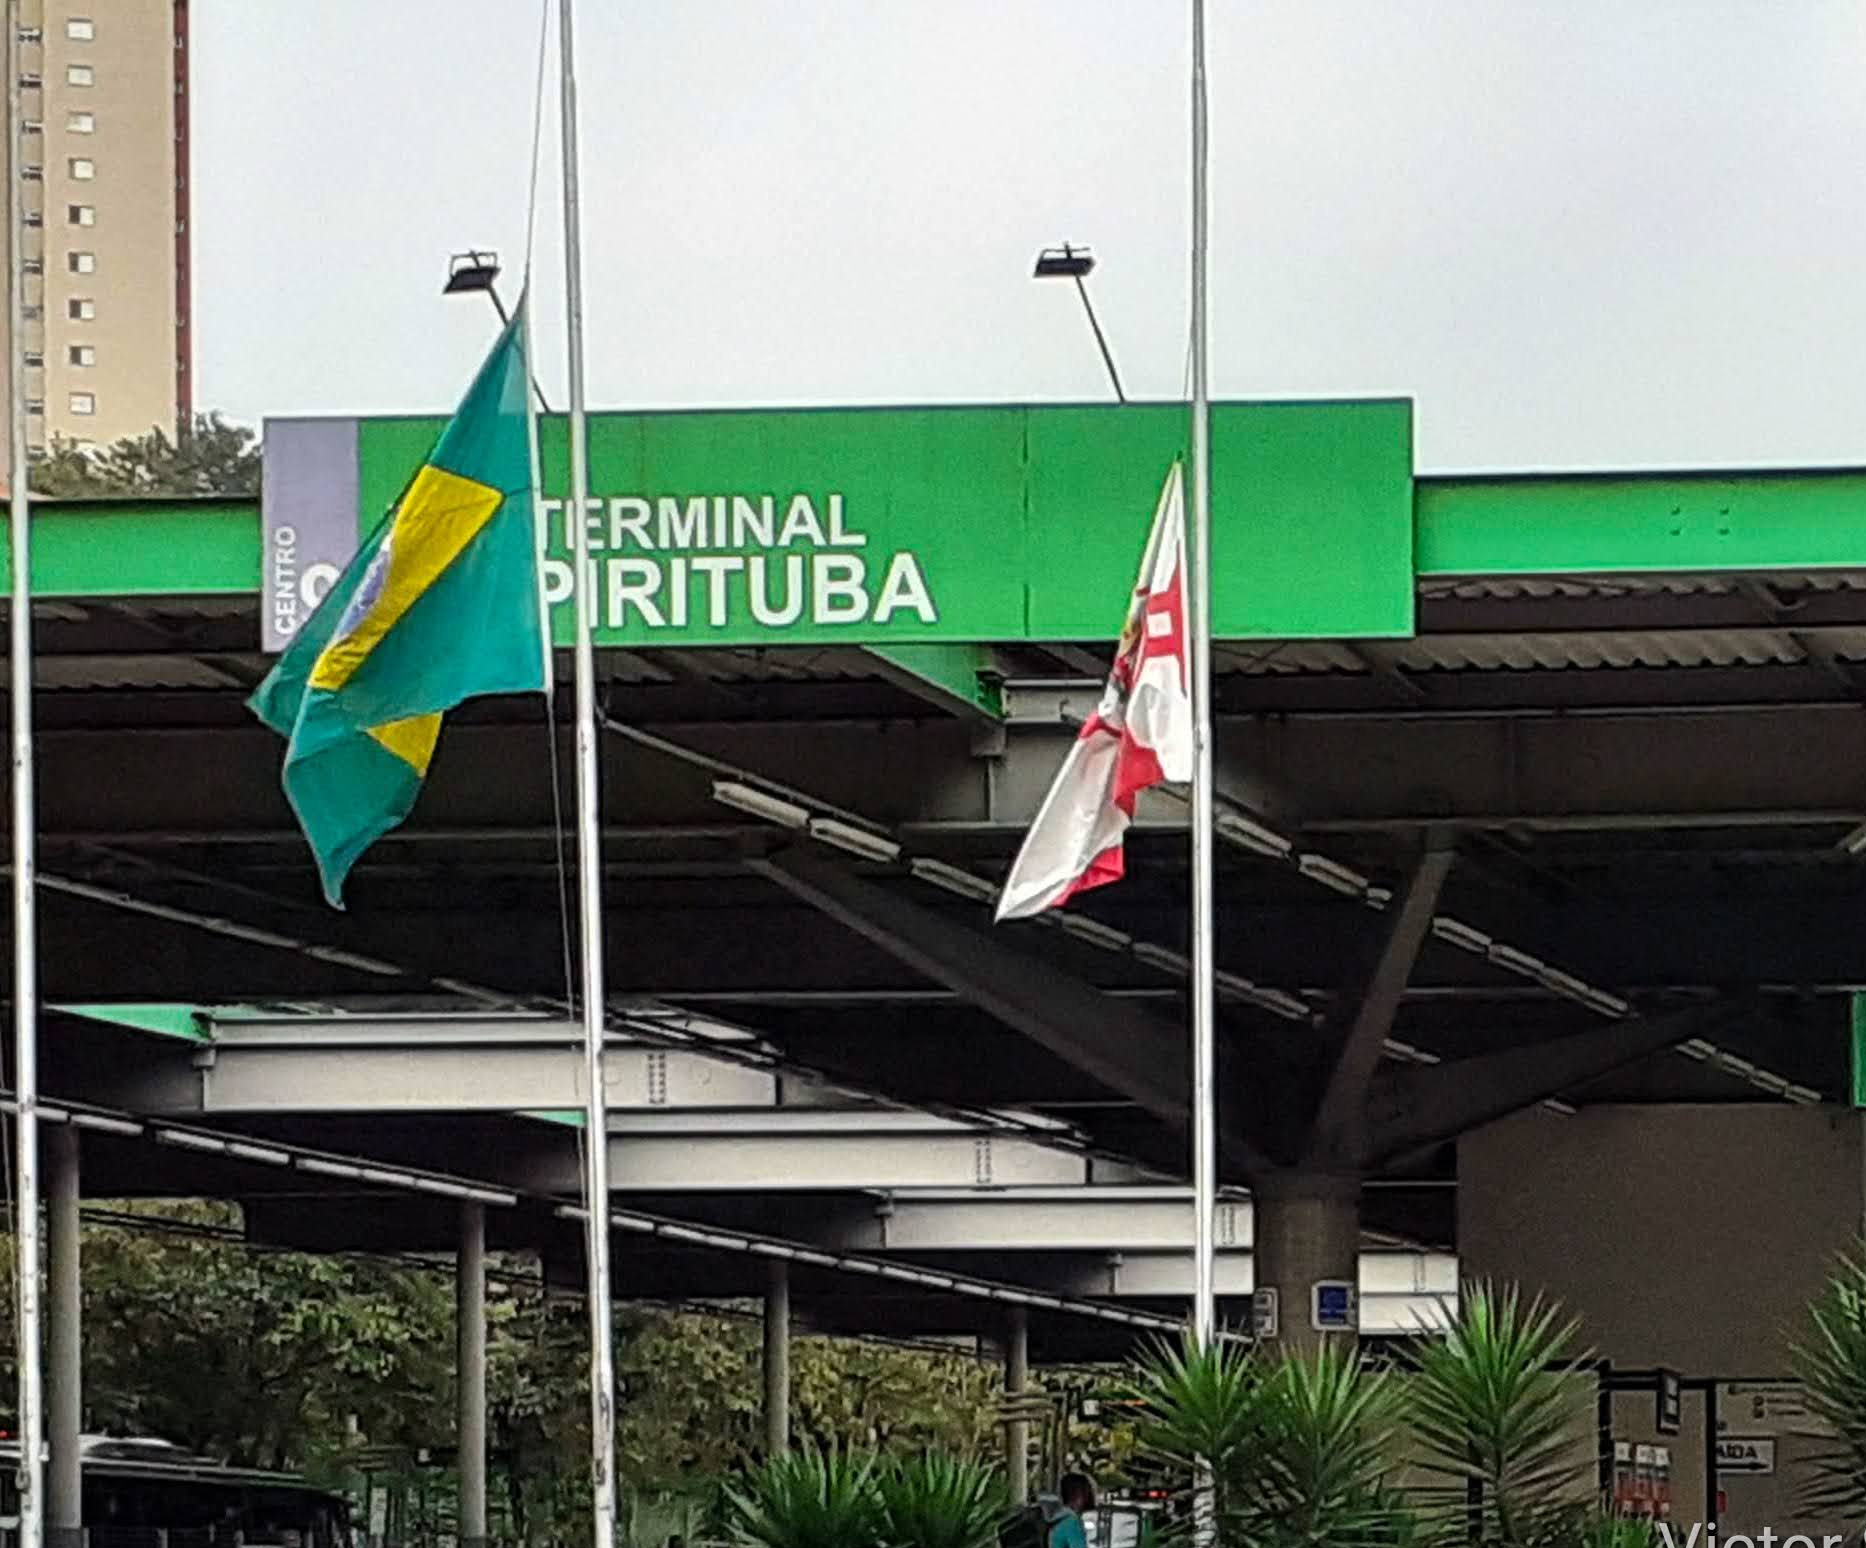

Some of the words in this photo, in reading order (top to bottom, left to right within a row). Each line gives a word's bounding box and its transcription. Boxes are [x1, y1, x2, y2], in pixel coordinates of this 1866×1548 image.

[540, 494, 867, 549] TERMINAL
[274, 525, 297, 635] CENTRO
[543, 552, 938, 628] PIRITUBA
